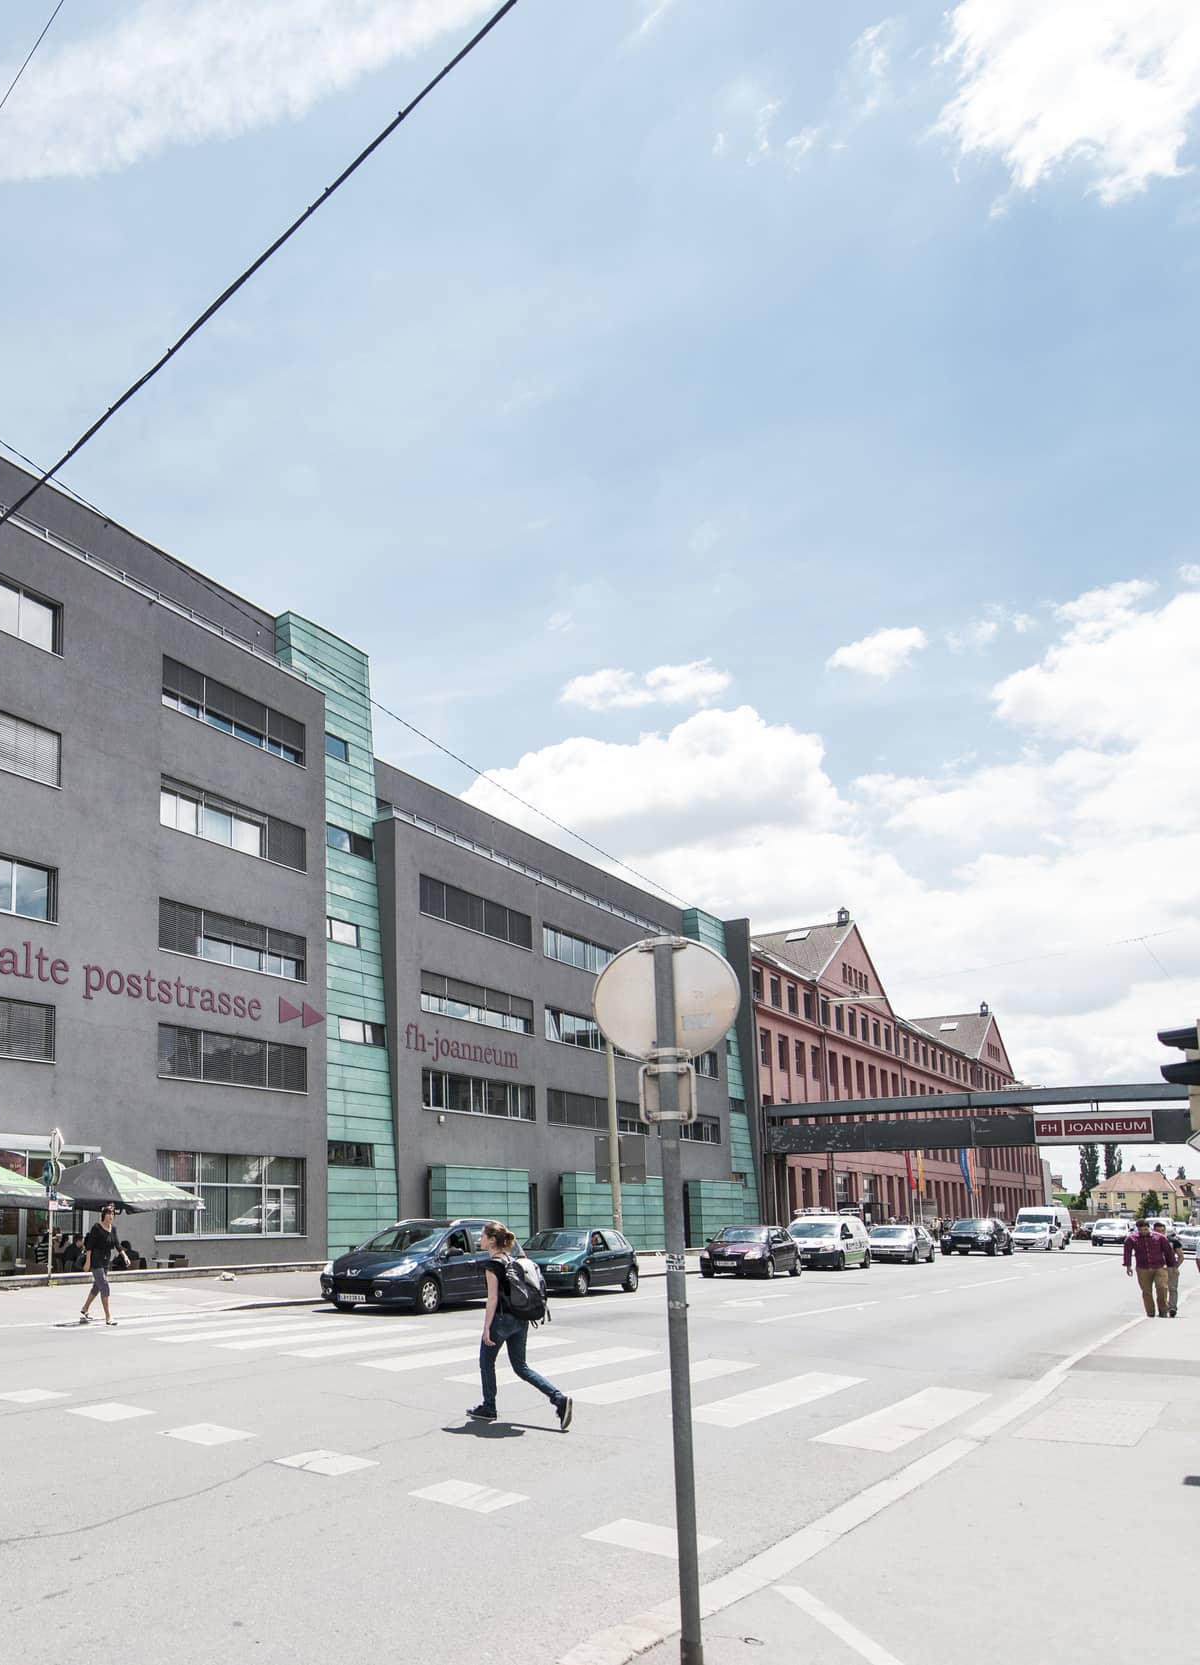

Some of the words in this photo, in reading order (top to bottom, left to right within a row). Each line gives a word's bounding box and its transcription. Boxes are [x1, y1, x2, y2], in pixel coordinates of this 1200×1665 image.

[83, 963, 262, 1021] poststrasse
[405, 1023, 519, 1069] fh-joanneum
[1040, 1124, 1057, 1133] FH
[1067, 1120, 1147, 1133] JOANNEUM
